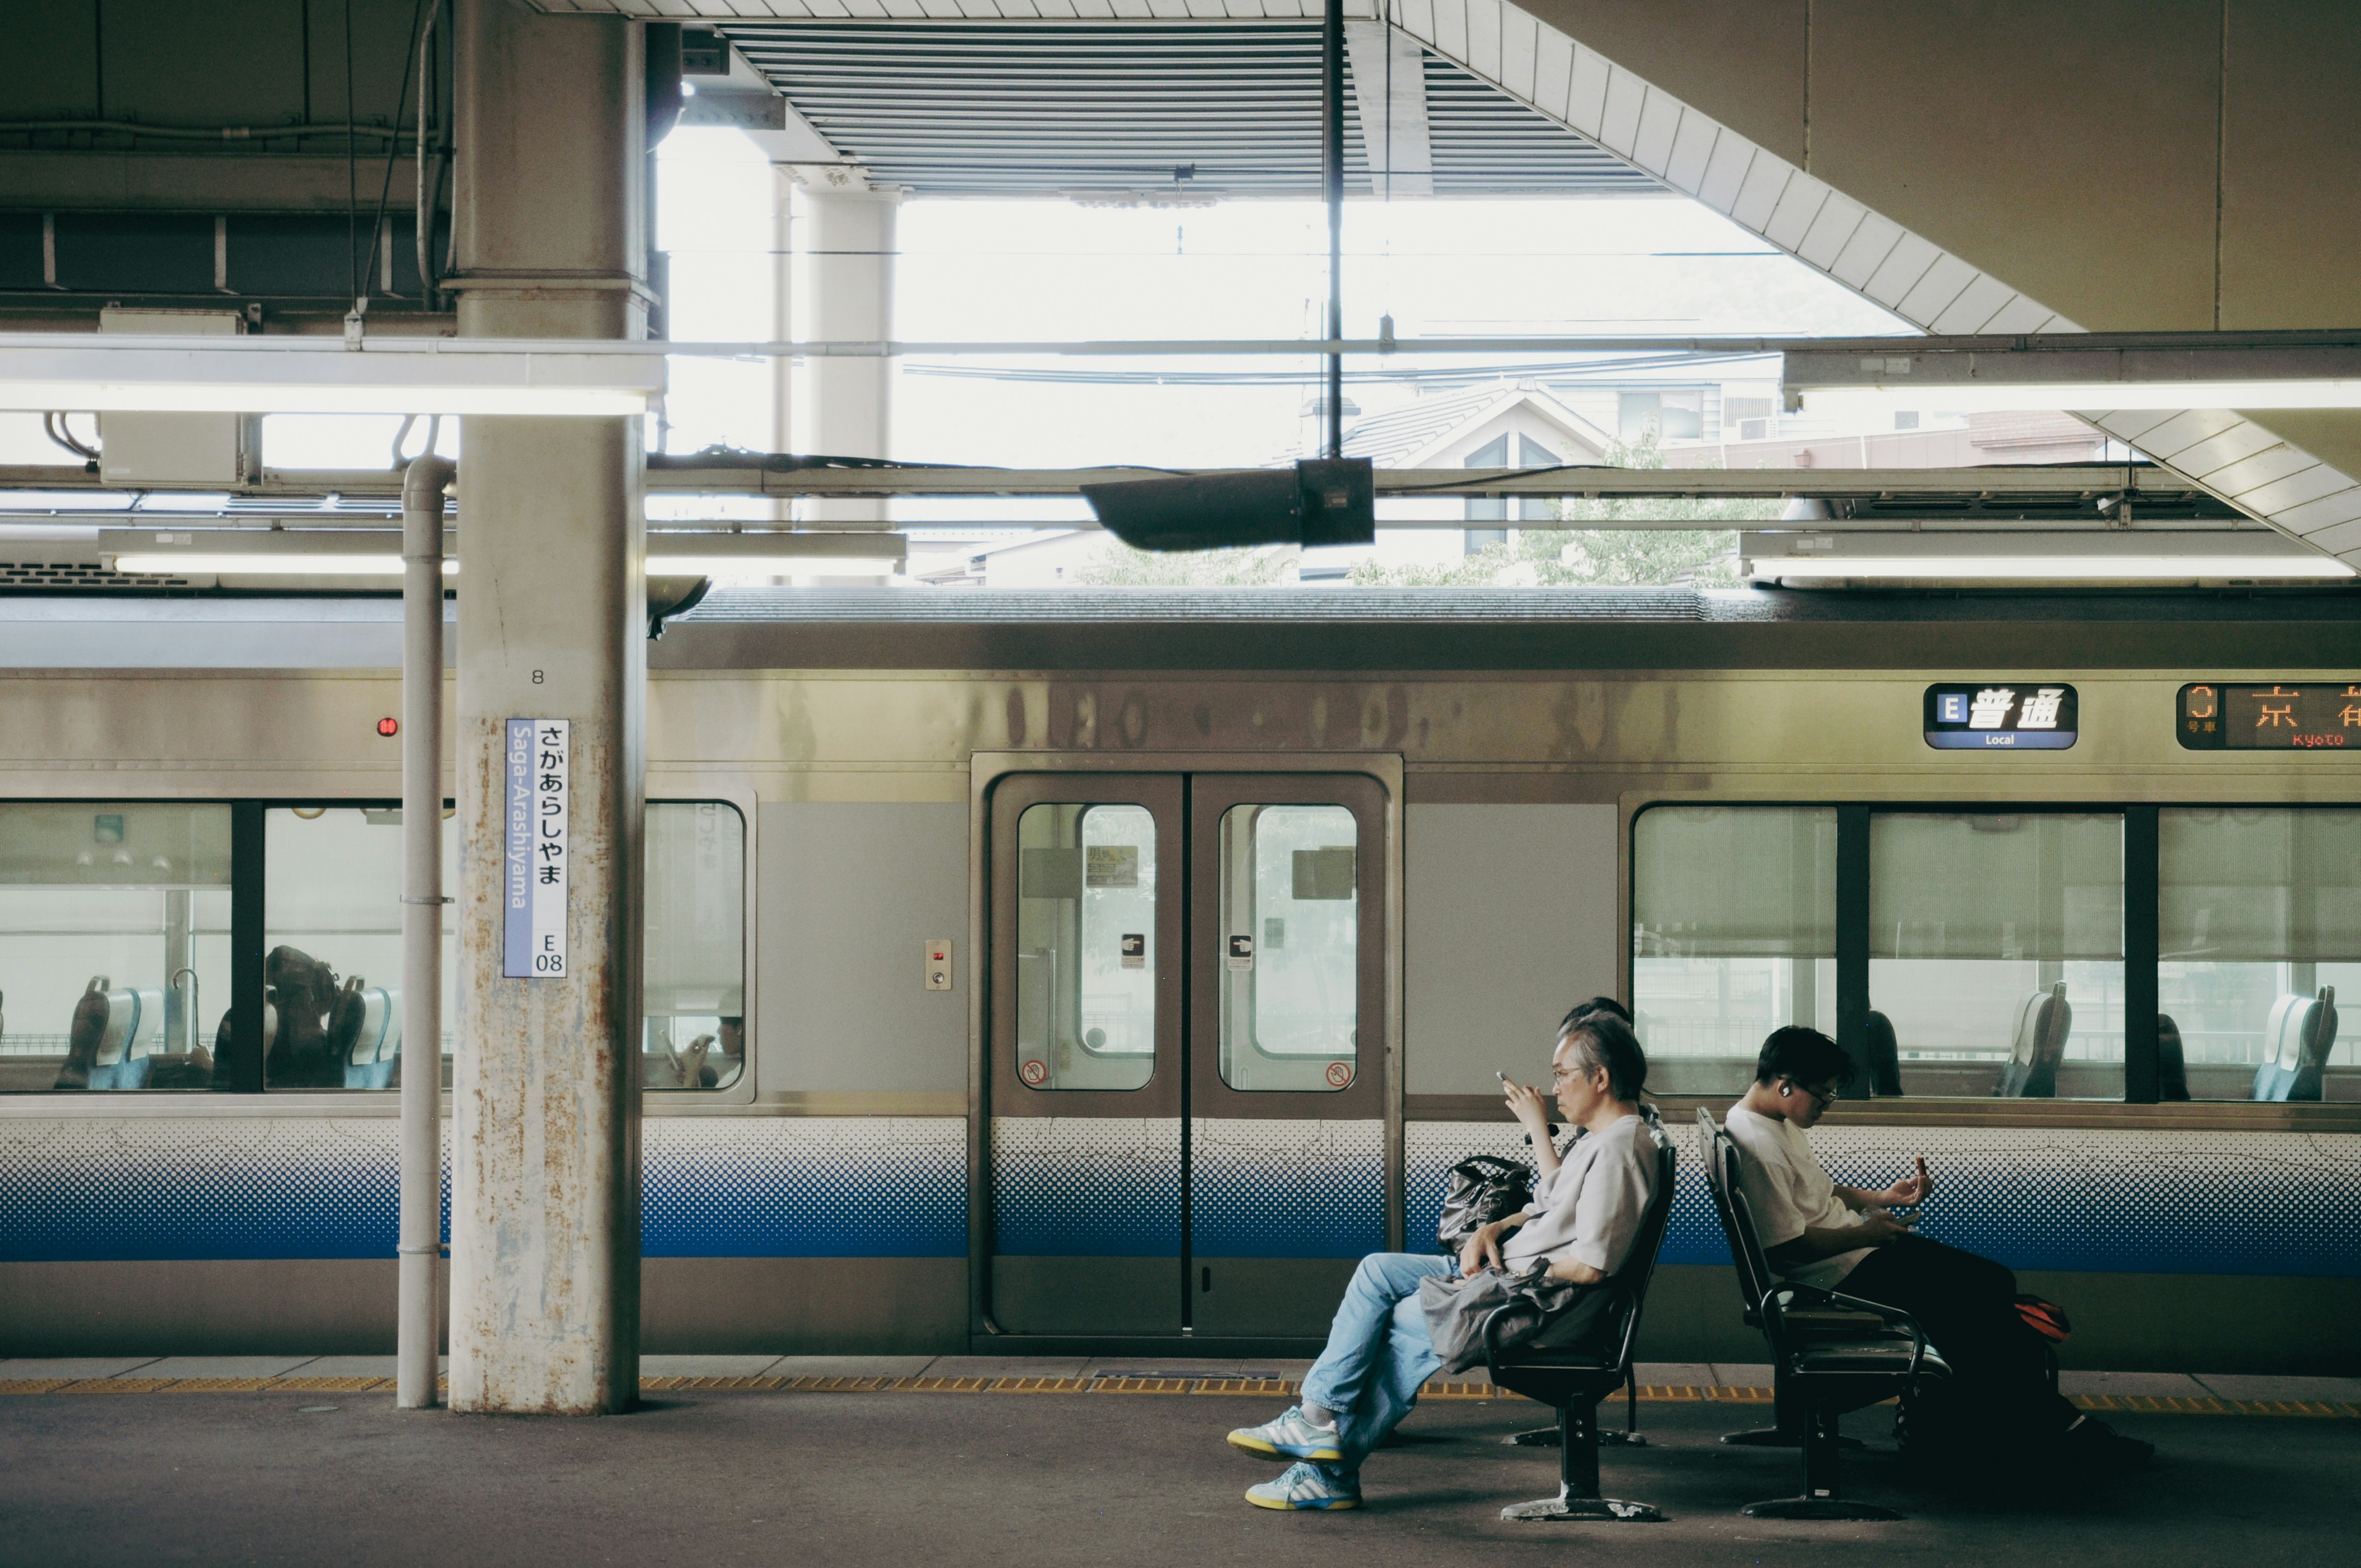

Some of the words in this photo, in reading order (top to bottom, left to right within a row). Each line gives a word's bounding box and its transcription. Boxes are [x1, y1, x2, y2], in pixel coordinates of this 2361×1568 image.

[532, 670, 544, 684] 8
[1945, 697, 1959, 720] E
[1969, 689, 2065, 729] 普通
[2188, 721, 2217, 733] 号車
[1986, 734, 2014, 745] Local
[539, 727, 564, 885] さがあらしやま
[508, 727, 532, 909] Saga-Arashiyama
[545, 935, 555, 951] E
[536, 955, 563, 972] 08
